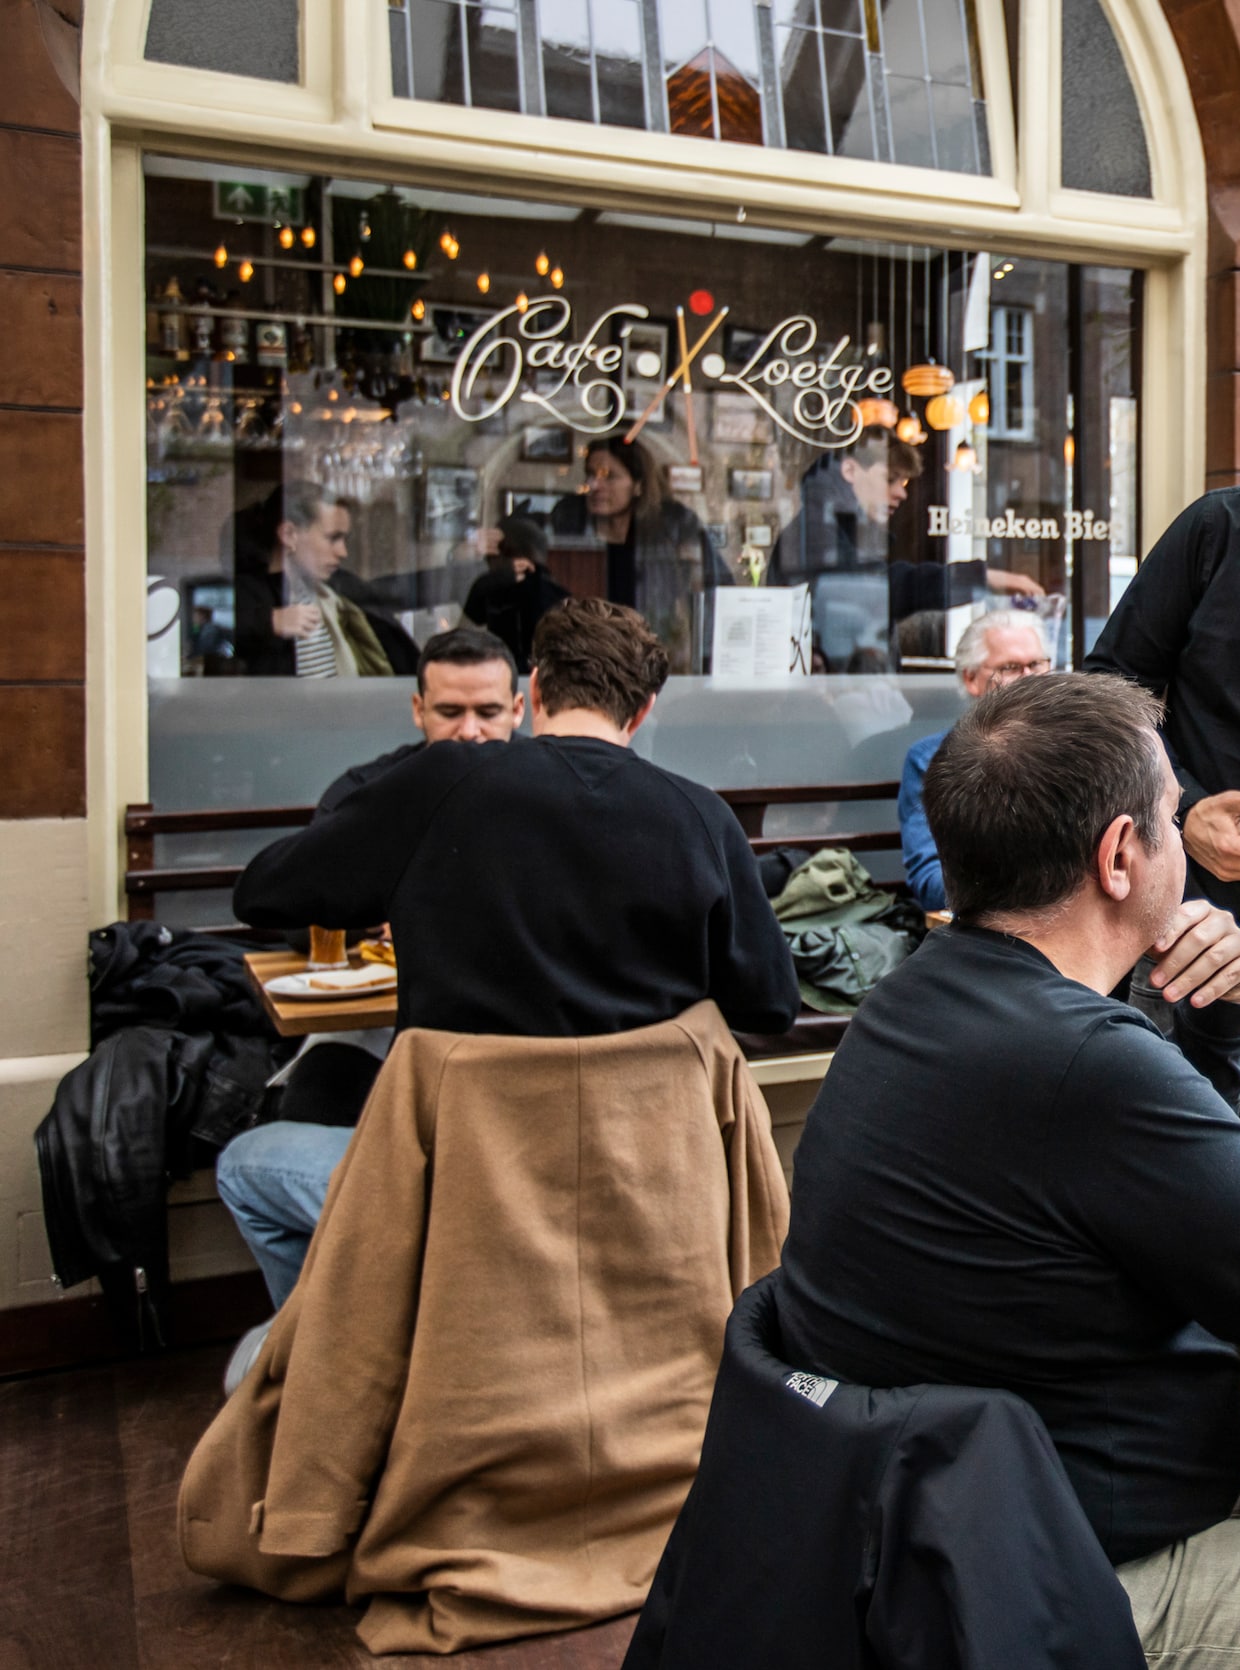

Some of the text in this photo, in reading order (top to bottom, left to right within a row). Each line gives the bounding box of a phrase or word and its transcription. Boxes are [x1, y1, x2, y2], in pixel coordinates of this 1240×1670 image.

[720, 314, 895, 448] Loetje
[927, 505, 1060, 539] Heineken
[785, 1376, 814, 1397] FACE
